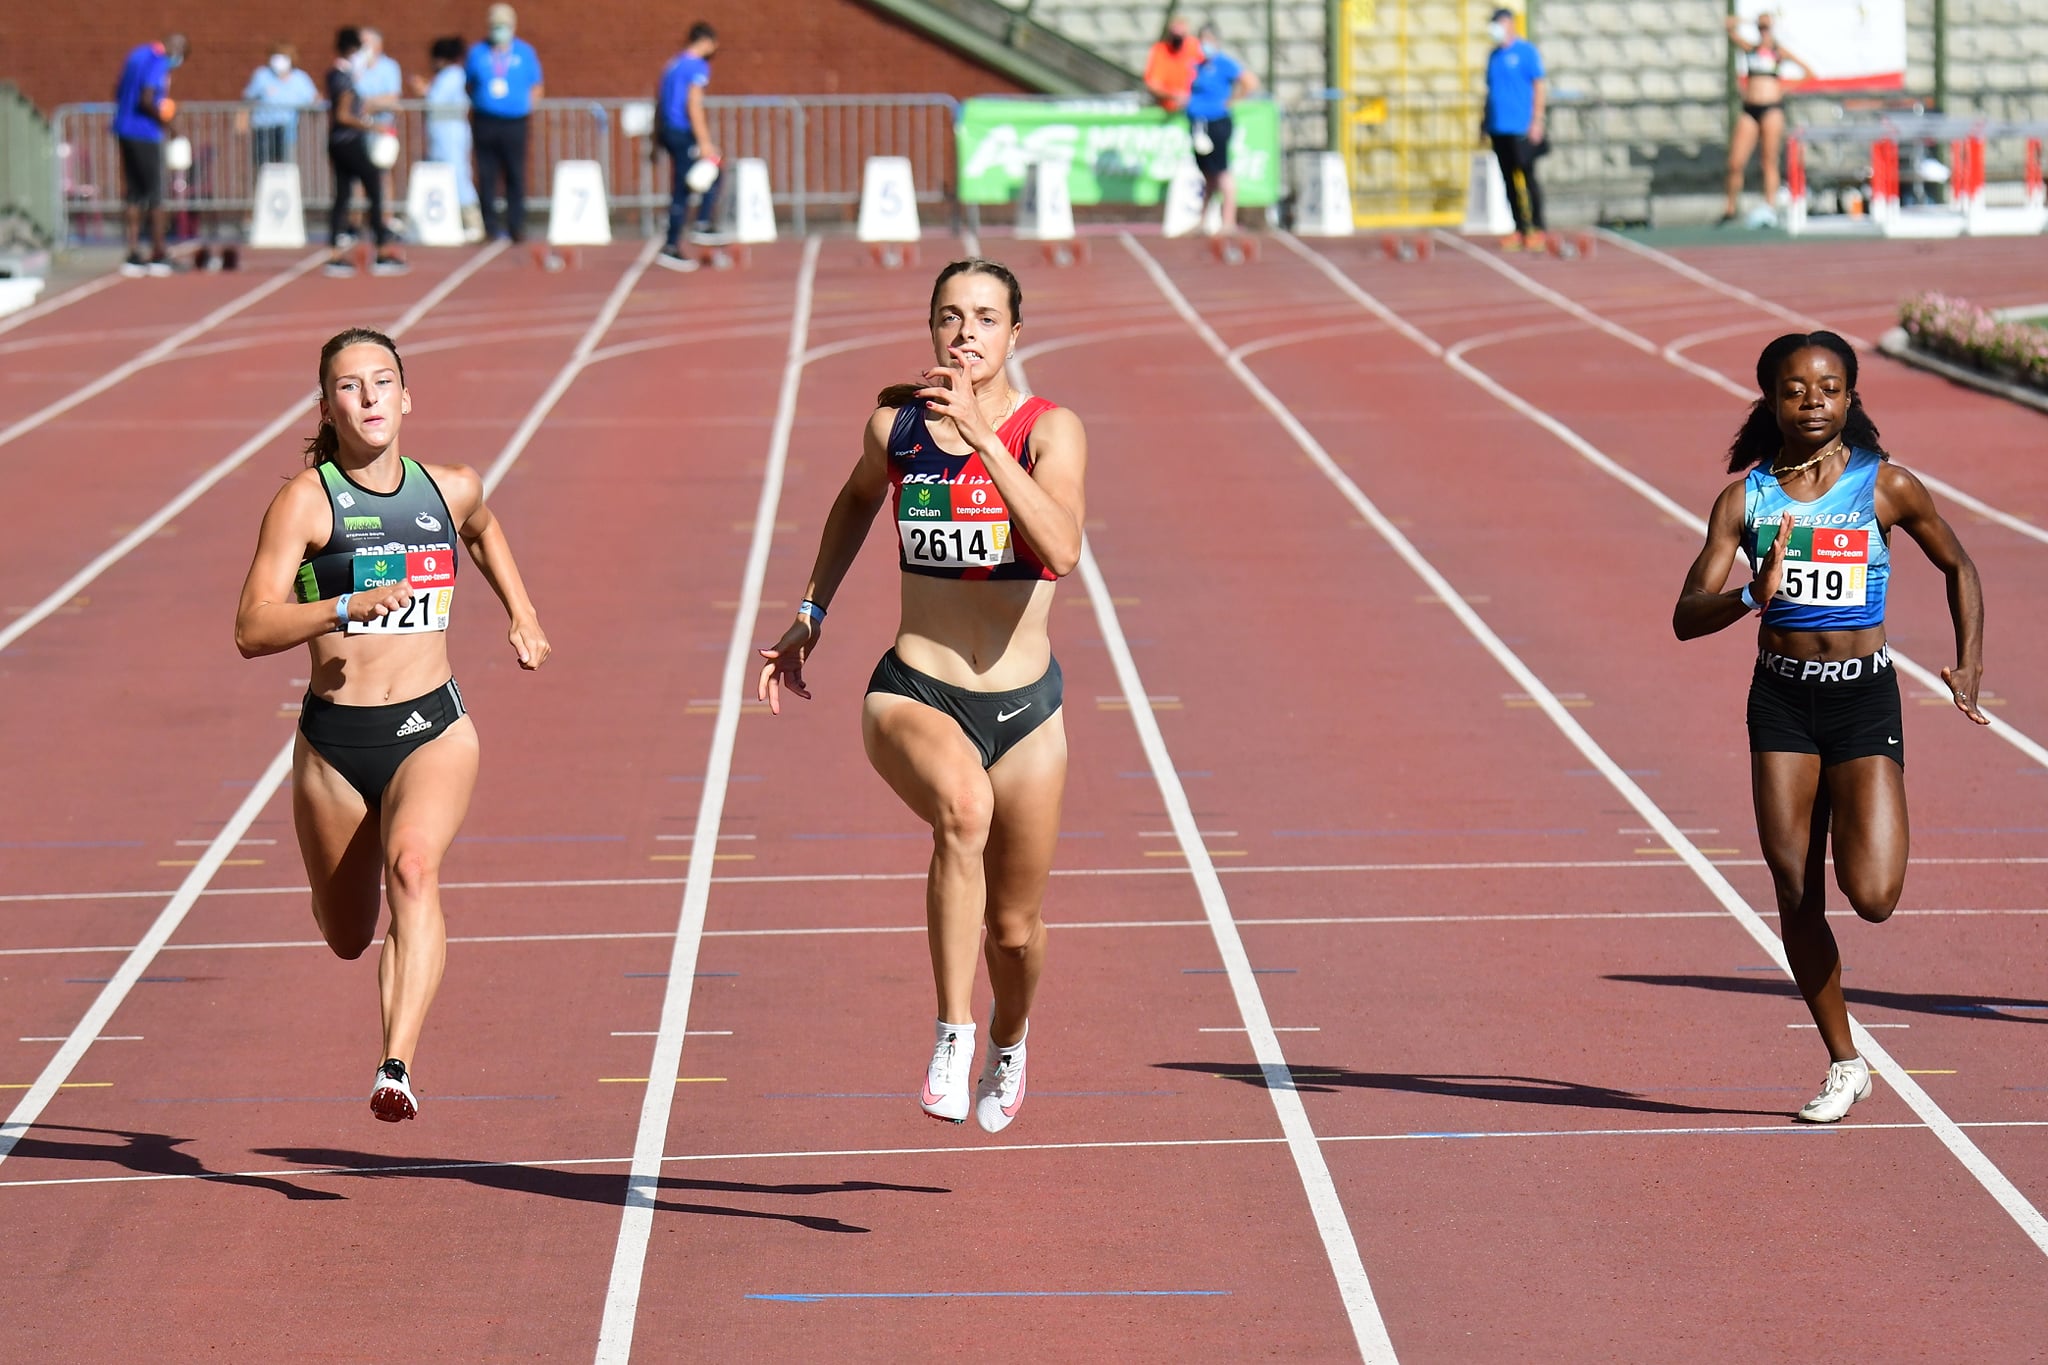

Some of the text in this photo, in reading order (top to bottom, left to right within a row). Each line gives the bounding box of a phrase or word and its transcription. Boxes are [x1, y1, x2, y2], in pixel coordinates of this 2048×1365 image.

[425, 188, 446, 222] 8
[571, 187, 590, 222] 7
[880, 180, 903, 216] 5
[908, 507, 941, 517] Crelan
[956, 506, 1003, 516] tempo-team
[910, 528, 988, 562] 2614
[1817, 548, 1864, 558] tempo-team
[364, 577, 397, 588] Crelan
[411, 573, 450, 583] tempo-team
[1777, 568, 1843, 600] 519
[1801, 658, 1863, 682] PRO
[396, 721, 433, 737] adidas
